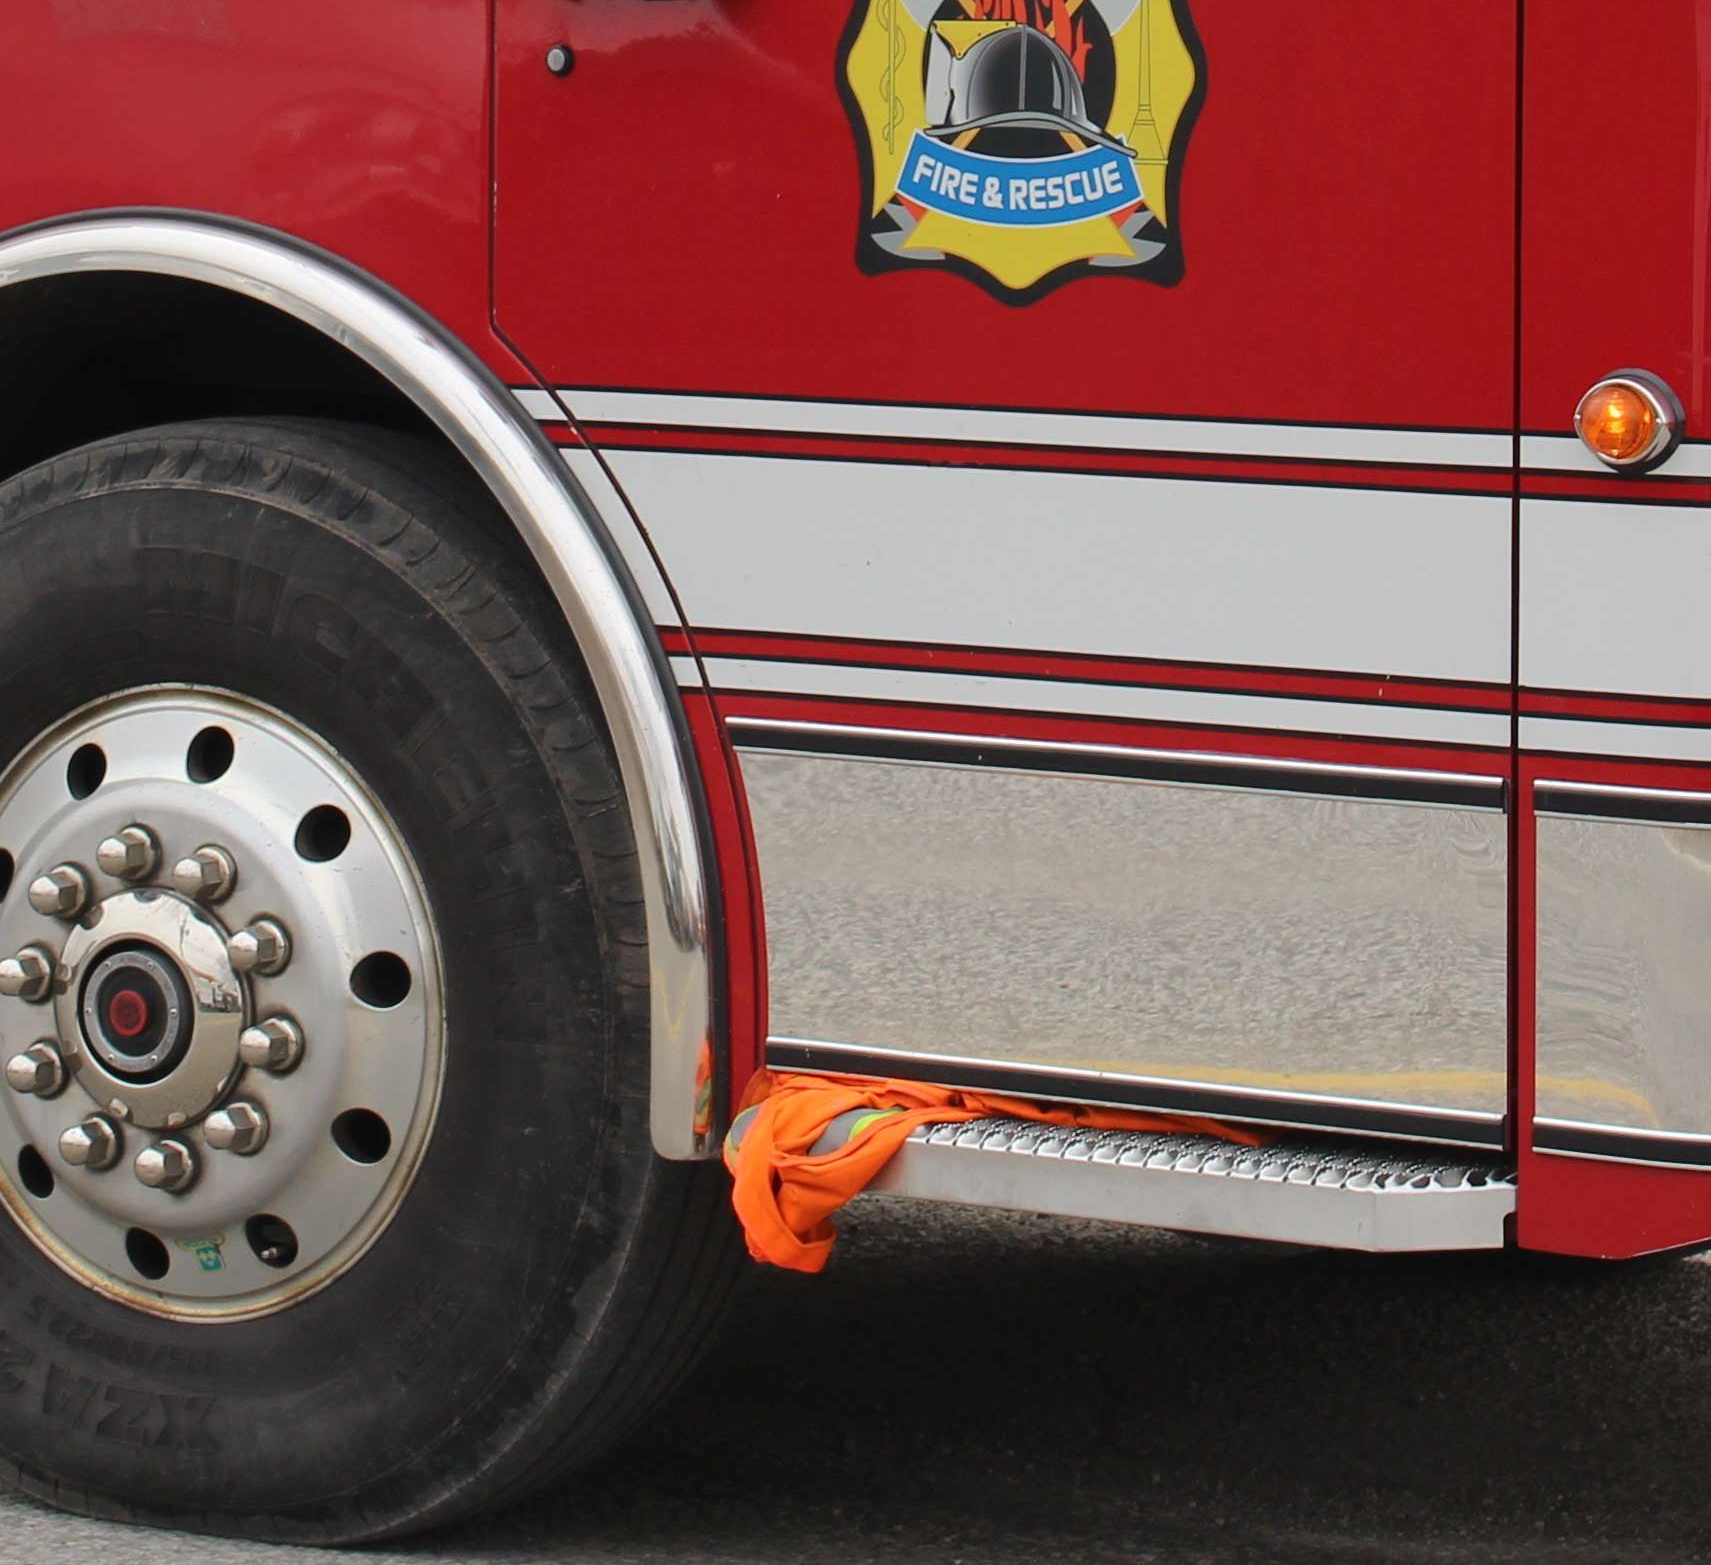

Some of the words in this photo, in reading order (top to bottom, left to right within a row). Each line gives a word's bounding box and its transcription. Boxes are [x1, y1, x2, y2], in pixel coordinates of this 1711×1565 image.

[912, 153, 978, 205] FIRE
[983, 178, 1004, 210] &
[1008, 159, 1124, 211] RESCUE
